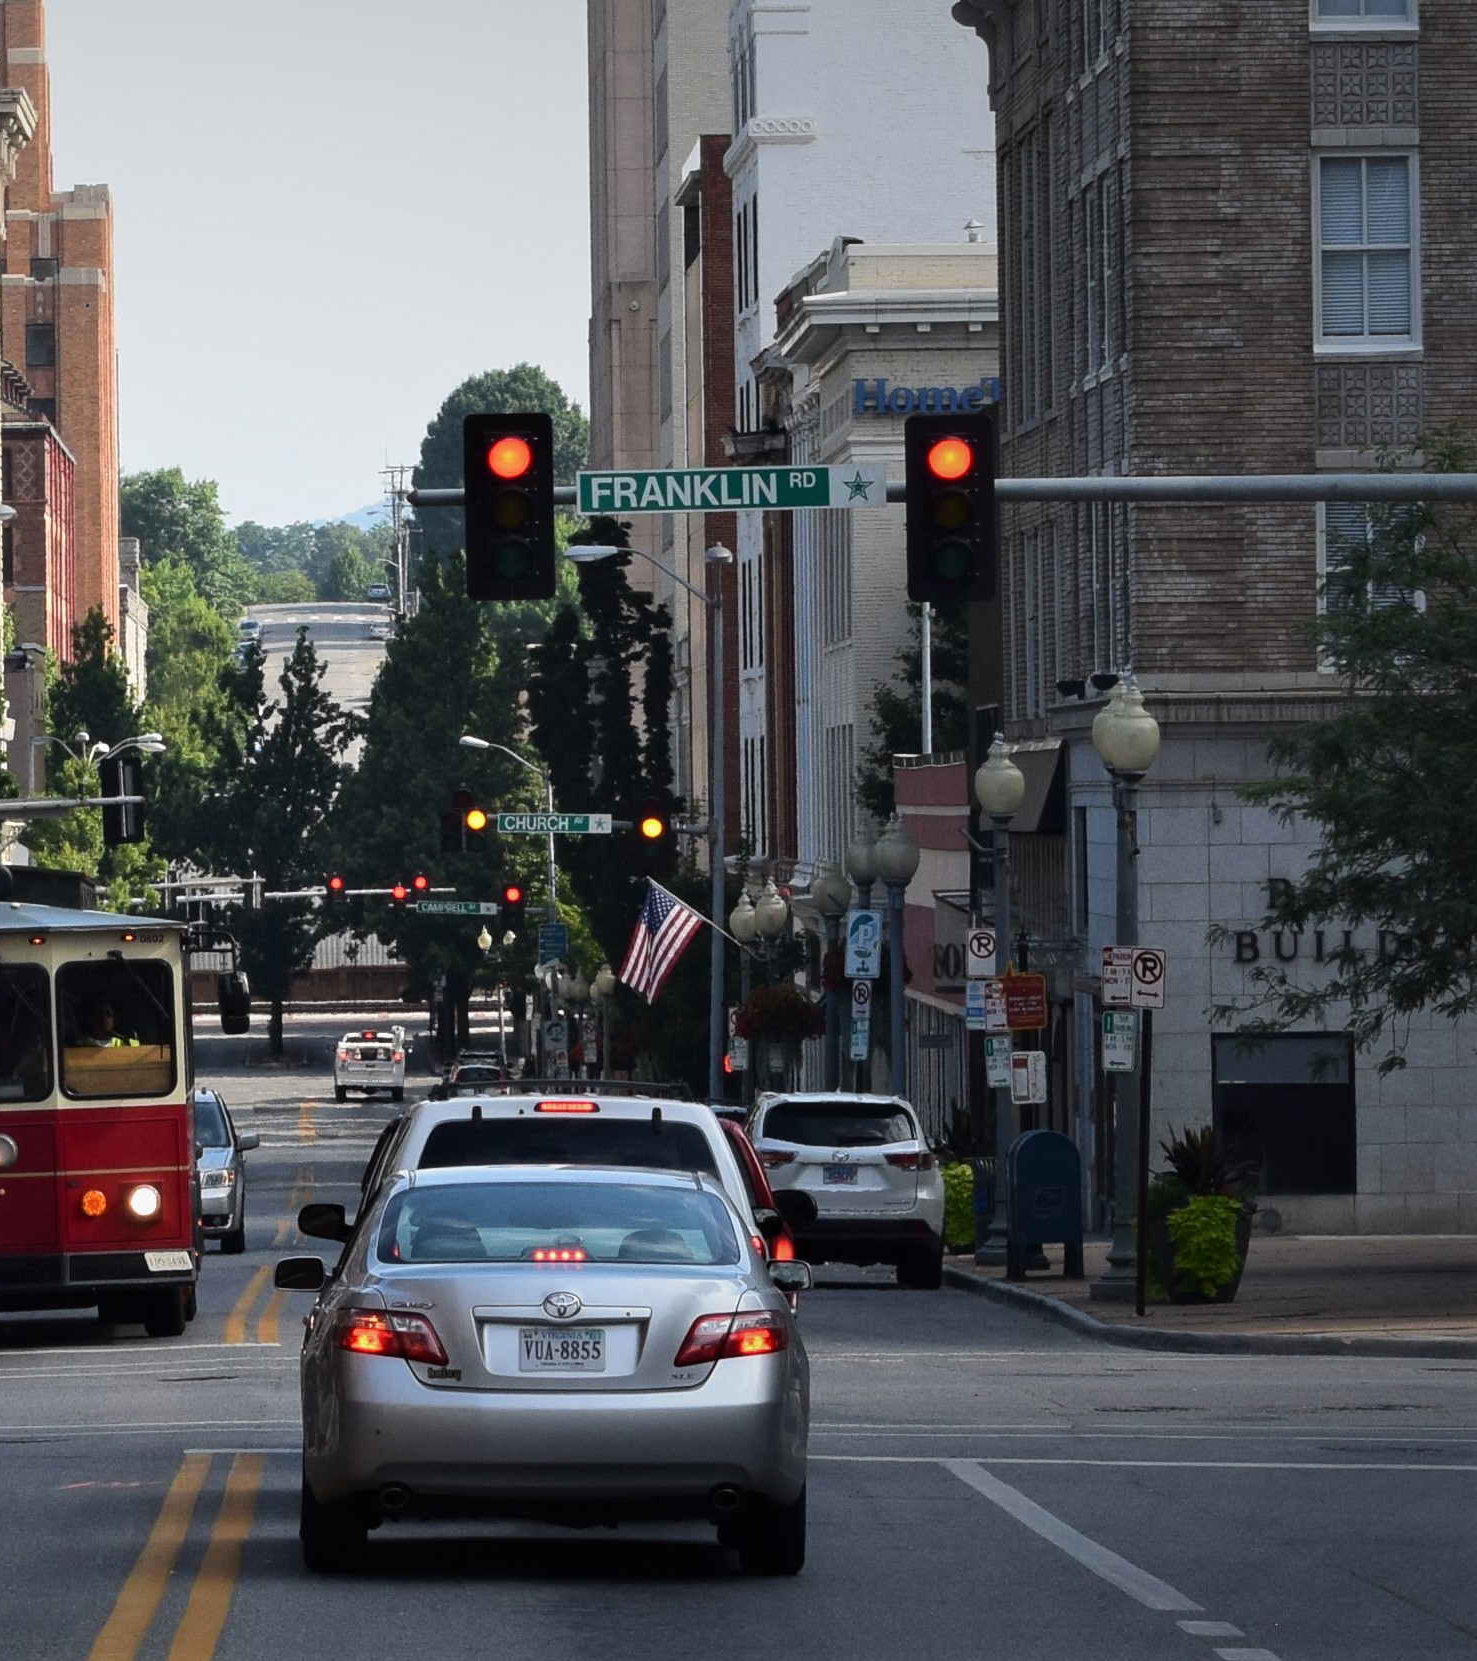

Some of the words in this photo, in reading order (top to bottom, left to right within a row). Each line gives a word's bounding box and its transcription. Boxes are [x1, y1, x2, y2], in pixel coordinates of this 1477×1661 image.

[591, 473, 778, 509] FRANKLIN
[789, 472, 816, 489] RD
[504, 815, 569, 831] CHURCH
[421, 903, 467, 913] CAMPBELL
[139, 934, 164, 943] 0802
[541, 1331, 583, 1340] VIRGINIA
[524, 1340, 602, 1361] VUA-8855
